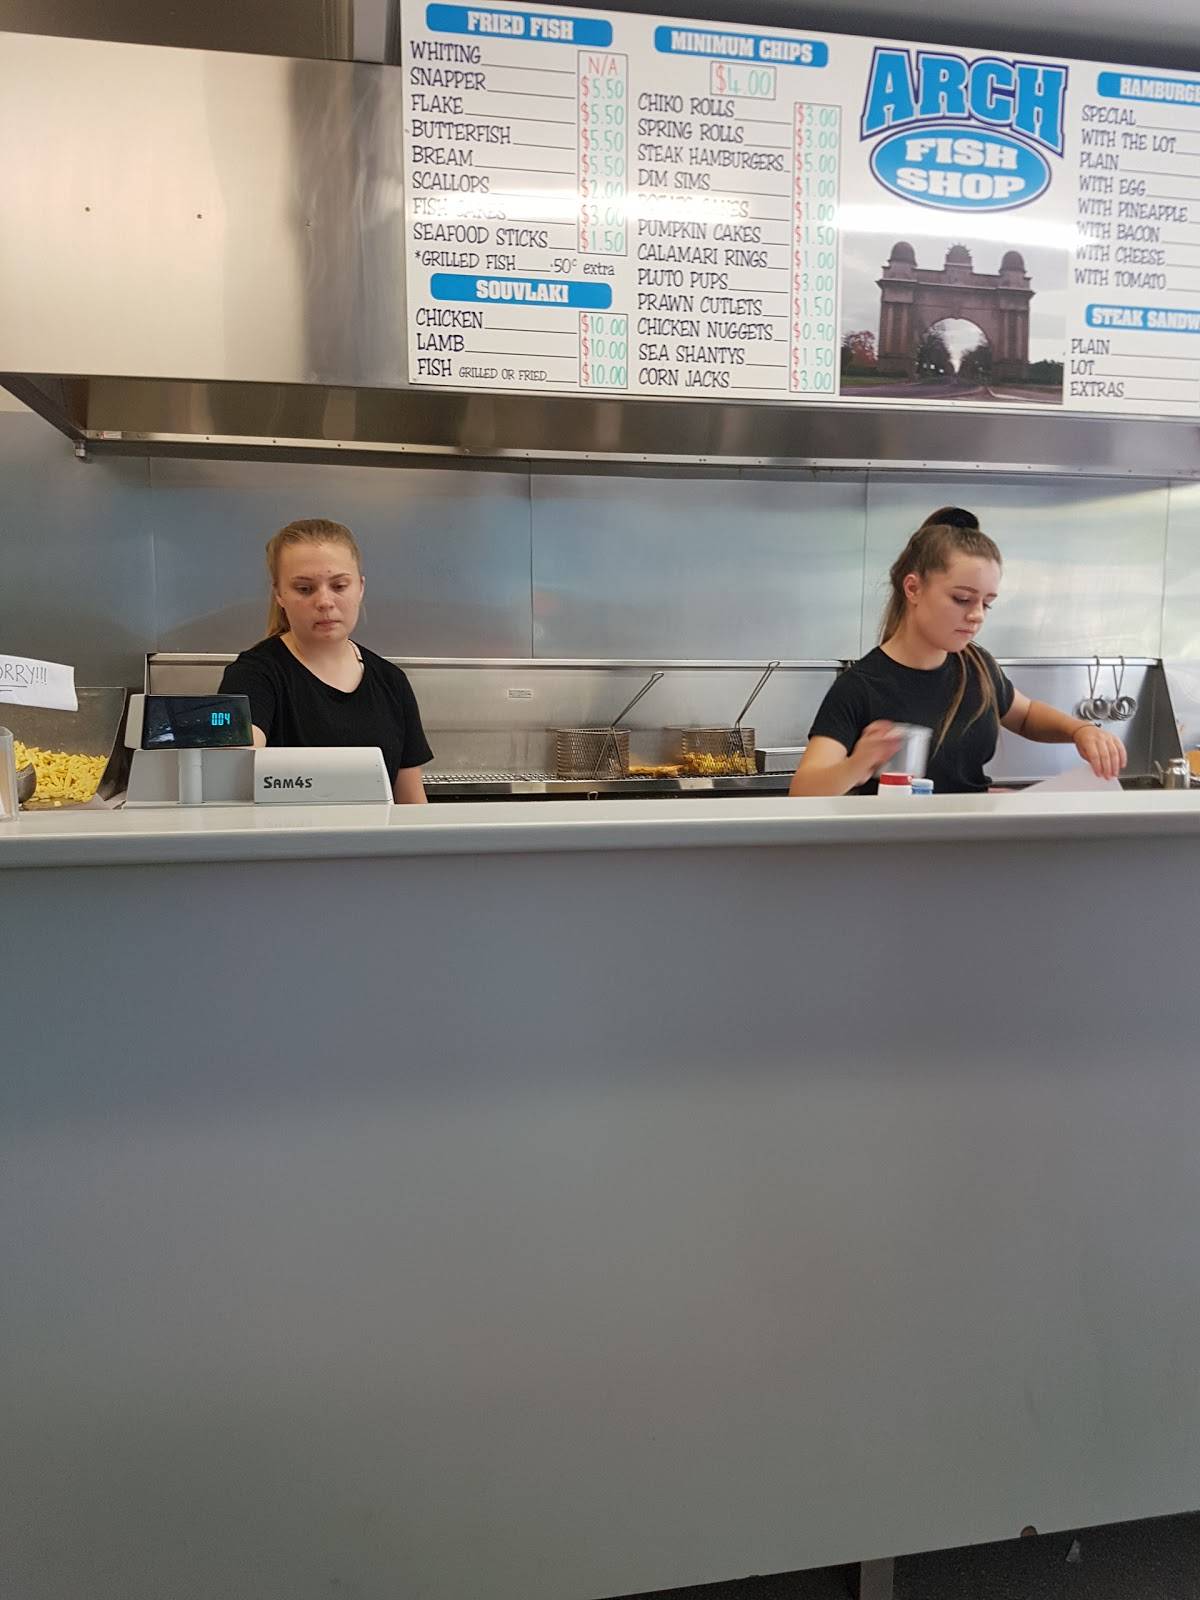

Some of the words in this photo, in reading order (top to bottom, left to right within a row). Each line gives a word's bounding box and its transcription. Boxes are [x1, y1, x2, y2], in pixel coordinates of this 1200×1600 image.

[467, 11, 525, 36] FRIED
[530, 17, 574, 41] FISH
[410, 40, 482, 65] WHITING
[588, 55, 618, 76] N/A
[670, 30, 755, 58] MINIMUM
[758, 39, 813, 63] CHIPS
[410, 66, 487, 91] SNAPPER
[580, 75, 624, 99] $5.50
[715, 63, 772, 97] $4.00
[411, 94, 464, 115] FLAKE
[580, 102, 624, 126] $5.50
[638, 92, 684, 114] CHIKO
[690, 97, 735, 118] ROLLS
[796, 104, 838, 126] $3.00
[860, 46, 1069, 159] ARCH
[1082, 104, 1136, 126] SPECIAL
[411, 120, 511, 145] BUTTERFISH
[581, 127, 624, 152] $5.50
[638, 118, 693, 140] SPRING
[700, 123, 744, 144] ROLLS
[796, 128, 838, 149] $3.00
[1081, 128, 1117, 148] WITH
[1121, 132, 1147, 151] THE
[1152, 135, 1177, 154] LOT
[411, 145, 474, 167] BREAM
[581, 153, 624, 177] $5.50
[638, 143, 684, 164] STEAK
[689, 147, 784, 171] HAMBURGERS
[796, 152, 837, 174] $5.00
[905, 137, 1018, 170] FISH
[1080, 151, 1119, 170] PLAIN
[412, 171, 490, 194] SCALLOPS
[638, 168, 668, 188] DIM
[674, 171, 711, 190] SIMS
[795, 176, 836, 199] $1.00
[896, 167, 1026, 201] SHOP
[1079, 174, 1113, 193] WITH
[1119, 179, 1146, 197] EGG
[413, 197, 448, 217] FIS
[795, 201, 836, 222] $1.00
[1078, 197, 1113, 216] WITH
[1118, 201, 1188, 223] PINEAPPLE
[413, 222, 489, 244] SEAFOOD
[495, 227, 548, 249] STICKS
[581, 228, 624, 252] $1.50
[638, 218, 707, 240] PUMPKIN
[713, 223, 761, 244] CAKES
[795, 225, 836, 247] $1.50
[1076, 220, 1111, 239] WITH
[1117, 223, 1160, 242] BACON
[486, 254, 516, 270] FISH
[583, 262, 615, 275] extra
[638, 243, 718, 265] CALAMARI
[724, 248, 768, 269] RINGS
[795, 250, 835, 269] $1.00
[1075, 244, 1110, 262] WITH
[1115, 246, 1166, 266] CHEESE
[475, 280, 569, 303] SOUVLAKI
[638, 268, 684, 289] PLUTO
[690, 271, 729, 291] PUPS
[795, 273, 833, 293] $3.00
[1074, 267, 1109, 286] WITH
[1115, 271, 1166, 290] TOMATO
[638, 293, 694, 313] PRAWN
[700, 296, 763, 316] CUTLETS
[794, 297, 833, 318] $1.50
[1091, 306, 1144, 326] STEAK
[416, 308, 483, 329] CHICKEN
[581, 314, 626, 336] $10.00
[637, 317, 700, 338] CHICKEN
[707, 321, 774, 342] NUGGETS
[794, 321, 835, 343] $0.90
[417, 333, 465, 352] LAMB
[581, 336, 626, 359] $10.00
[638, 342, 670, 362] SEA
[676, 344, 745, 366] SHANTYS
[793, 346, 834, 368] $1.50
[1071, 338, 1110, 355] PLAIN
[418, 358, 452, 377] FISH
[458, 367, 498, 380] GRILLED
[501, 369, 515, 380] OR
[518, 370, 547, 382] FRIED
[581, 361, 626, 385] $10.00
[638, 367, 679, 387] CORN
[684, 370, 730, 389] JACKS
[793, 370, 833, 391] $3.00
[1071, 359, 1095, 376] LOT
[1070, 380, 1125, 398] EXTRAS
[211, 713, 231, 726] 004
